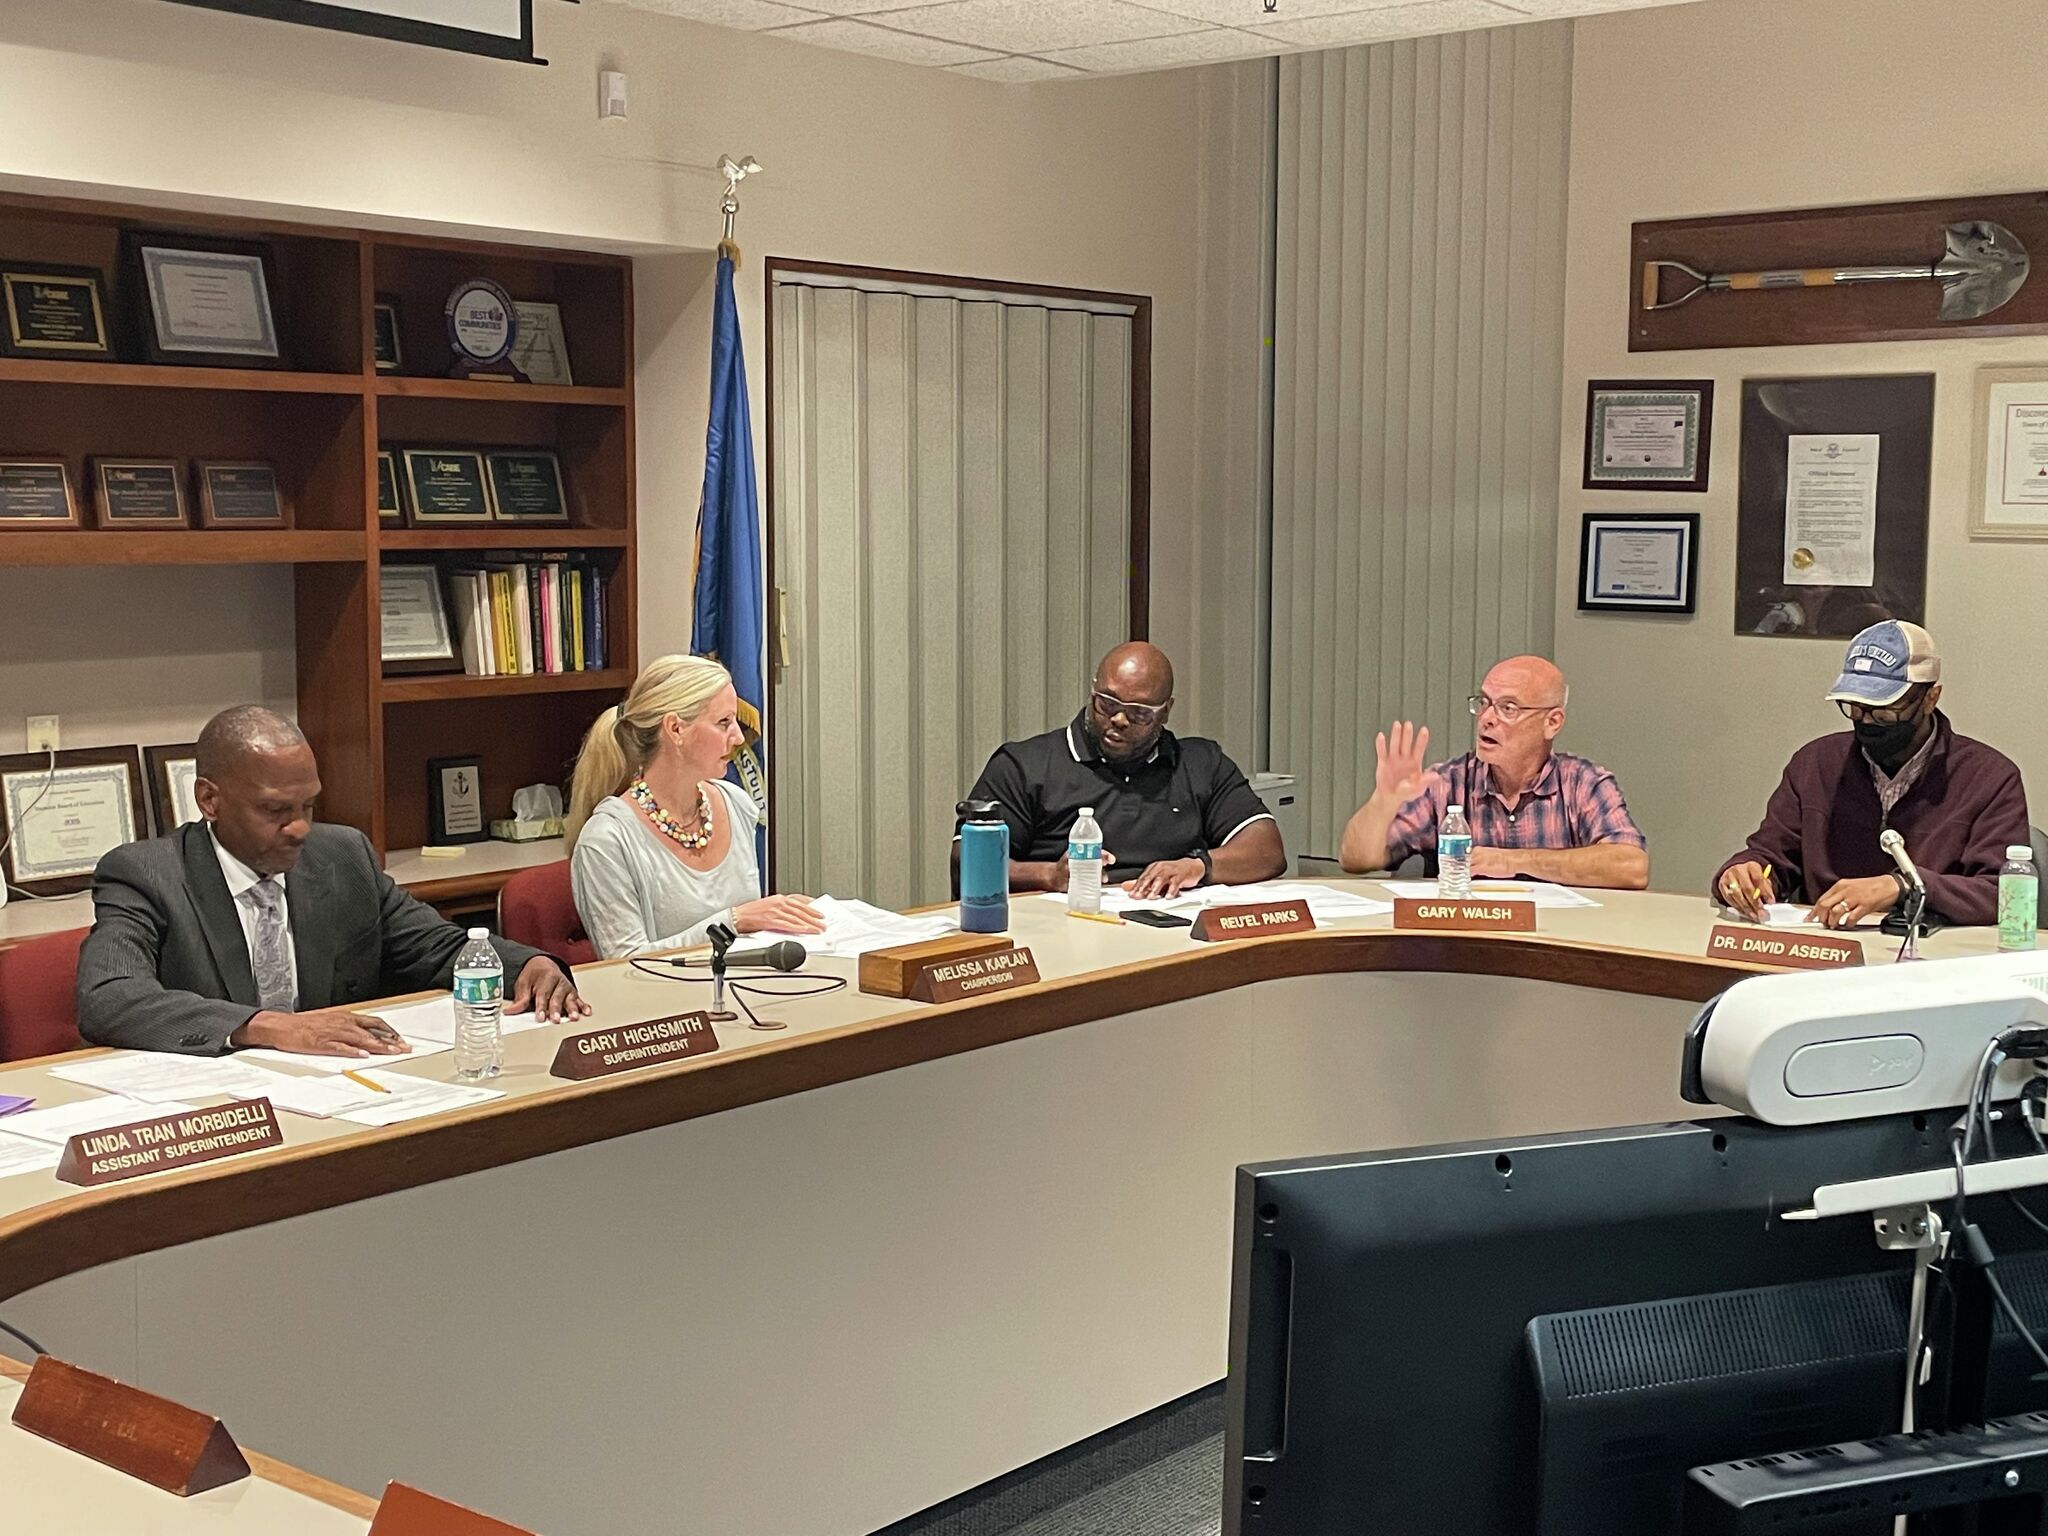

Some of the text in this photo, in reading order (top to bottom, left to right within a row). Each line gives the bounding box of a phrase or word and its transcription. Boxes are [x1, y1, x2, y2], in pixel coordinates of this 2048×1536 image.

[470, 310, 488, 320] BEST
[1219, 909, 1299, 930] REU'EL PARKS
[1417, 905, 1512, 920] GARY WALSH
[1713, 934, 1852, 963] DR. DAVID ASBERY
[932, 951, 1029, 983] MELISSA KAPLAN
[960, 971, 1014, 992] CHAIRPERSON
[577, 1016, 704, 1055] GARY HIGHSMITH
[603, 1038, 690, 1066] SUPERINTENDENT
[81, 1104, 267, 1157] LINDA TRAN MORBIDELLI
[91, 1125, 272, 1175] ASSISTANT SUPERINTENDENT
